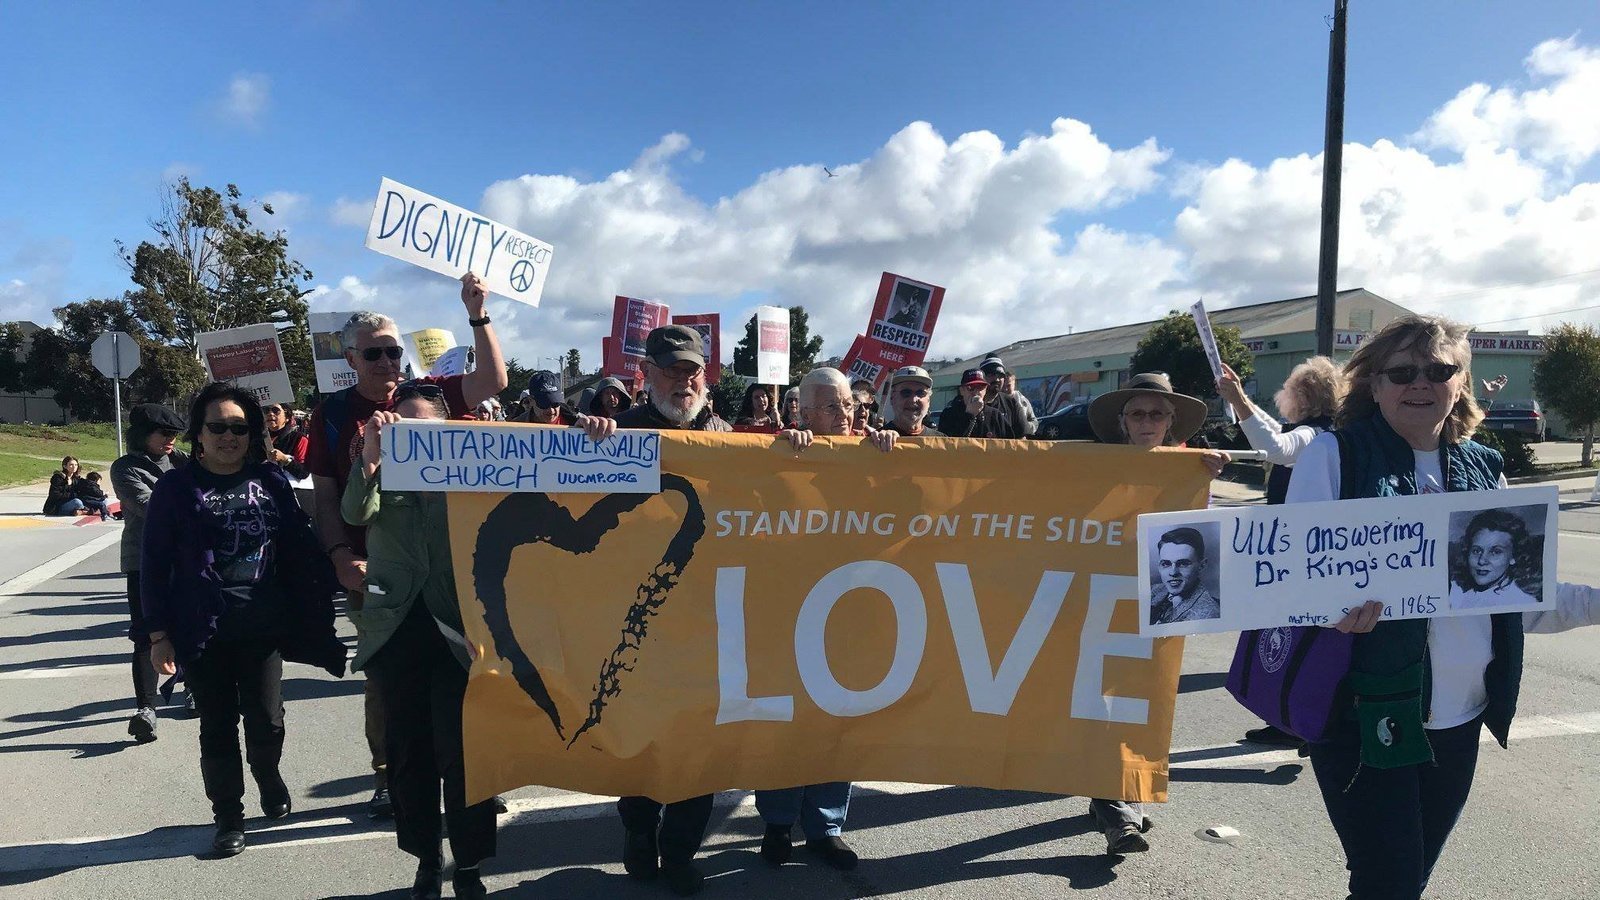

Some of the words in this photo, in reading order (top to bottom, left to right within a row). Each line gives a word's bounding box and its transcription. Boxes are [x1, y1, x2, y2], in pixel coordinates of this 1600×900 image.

[376, 190, 508, 278] DIGNITY
[504, 234, 552, 265] RESPECT
[872, 323, 928, 349] RESPECT!
[1336, 333, 1352, 345] LA
[1468, 338, 1497, 349] UPER
[623, 361, 641, 372] HER
[879, 349, 905, 364] HERE
[331, 371, 357, 380] UNITE
[849, 358, 880, 382] ONE
[332, 379, 357, 387] HERE!
[391, 426, 536, 464] UNITARIAN
[539, 429, 661, 462] UNIVERSALIST
[419, 463, 538, 489] CHURCH
[557, 471, 638, 485] UUCMP.ORG
[714, 508, 896, 537] STANDING
[907, 513, 961, 538] ON
[971, 513, 1036, 540] THE
[1045, 516, 1124, 546] SIDE
[1306, 516, 1425, 555] answering
[1255, 559, 1290, 588] Dr
[1306, 551, 1378, 589] King's
[1386, 539, 1436, 571] call
[1400, 594, 1441, 617] 1965
[714, 559, 1154, 726] LOVE
